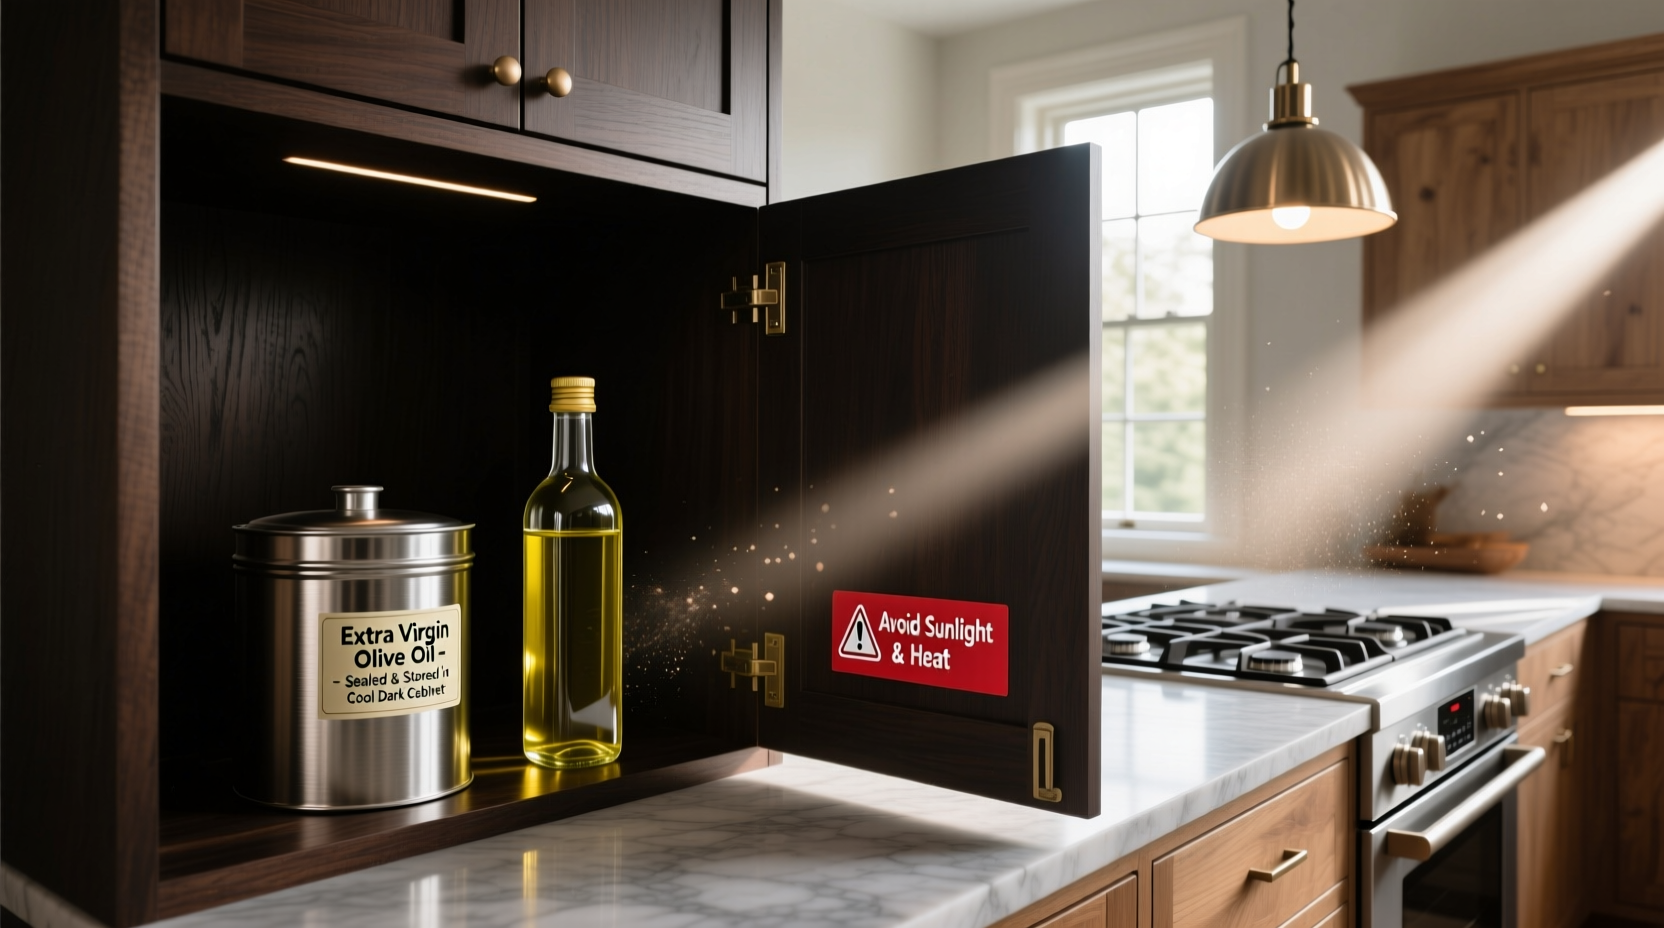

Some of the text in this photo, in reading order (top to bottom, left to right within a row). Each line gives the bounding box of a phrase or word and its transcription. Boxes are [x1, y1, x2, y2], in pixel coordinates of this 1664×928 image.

[341, 620, 449, 646] Extra Virgin
[878, 611, 994, 647] Avoid Sunlight
[354, 648, 405, 669] Olive
[411, 645, 435, 664] Oil
[891, 642, 951, 670] & Heat
[344, 673, 387, 688] Sealed
[390, 673, 399, 685] &
[347, 690, 375, 704] Cool
[378, 688, 405, 702] Dark
